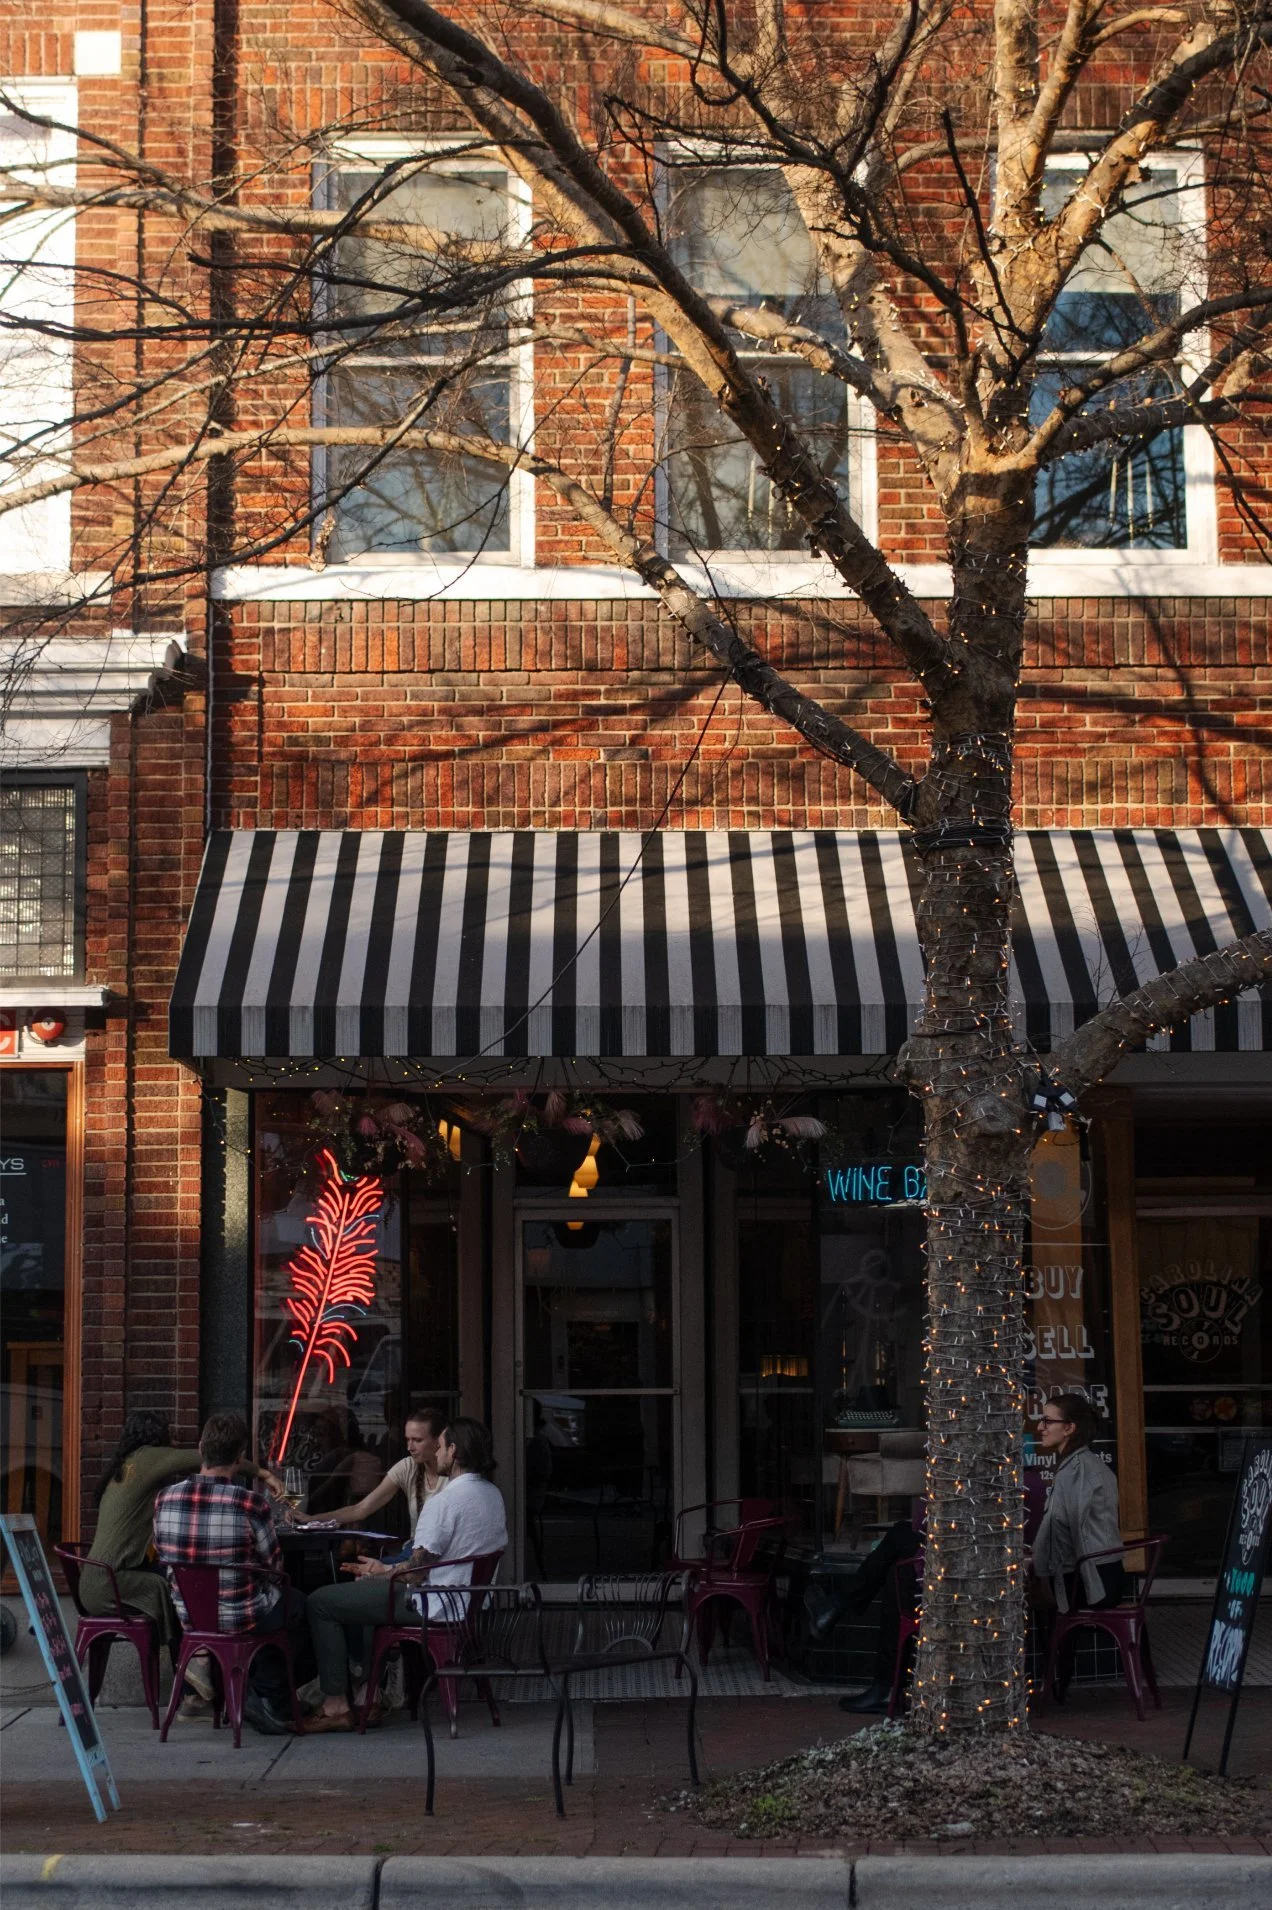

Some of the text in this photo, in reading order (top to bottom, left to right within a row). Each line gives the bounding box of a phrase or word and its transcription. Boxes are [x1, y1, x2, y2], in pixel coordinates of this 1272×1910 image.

[827, 1166, 893, 1202] WINE
[1022, 1265, 1084, 1300] BUY
[1139, 1259, 1264, 1307] CAROLINA
[1148, 1284, 1248, 1335] SOUL
[1020, 1325, 1095, 1360] SELL
[1162, 1331, 1240, 1350] RECORDS
[1025, 1453, 1057, 1467] Vinyl
